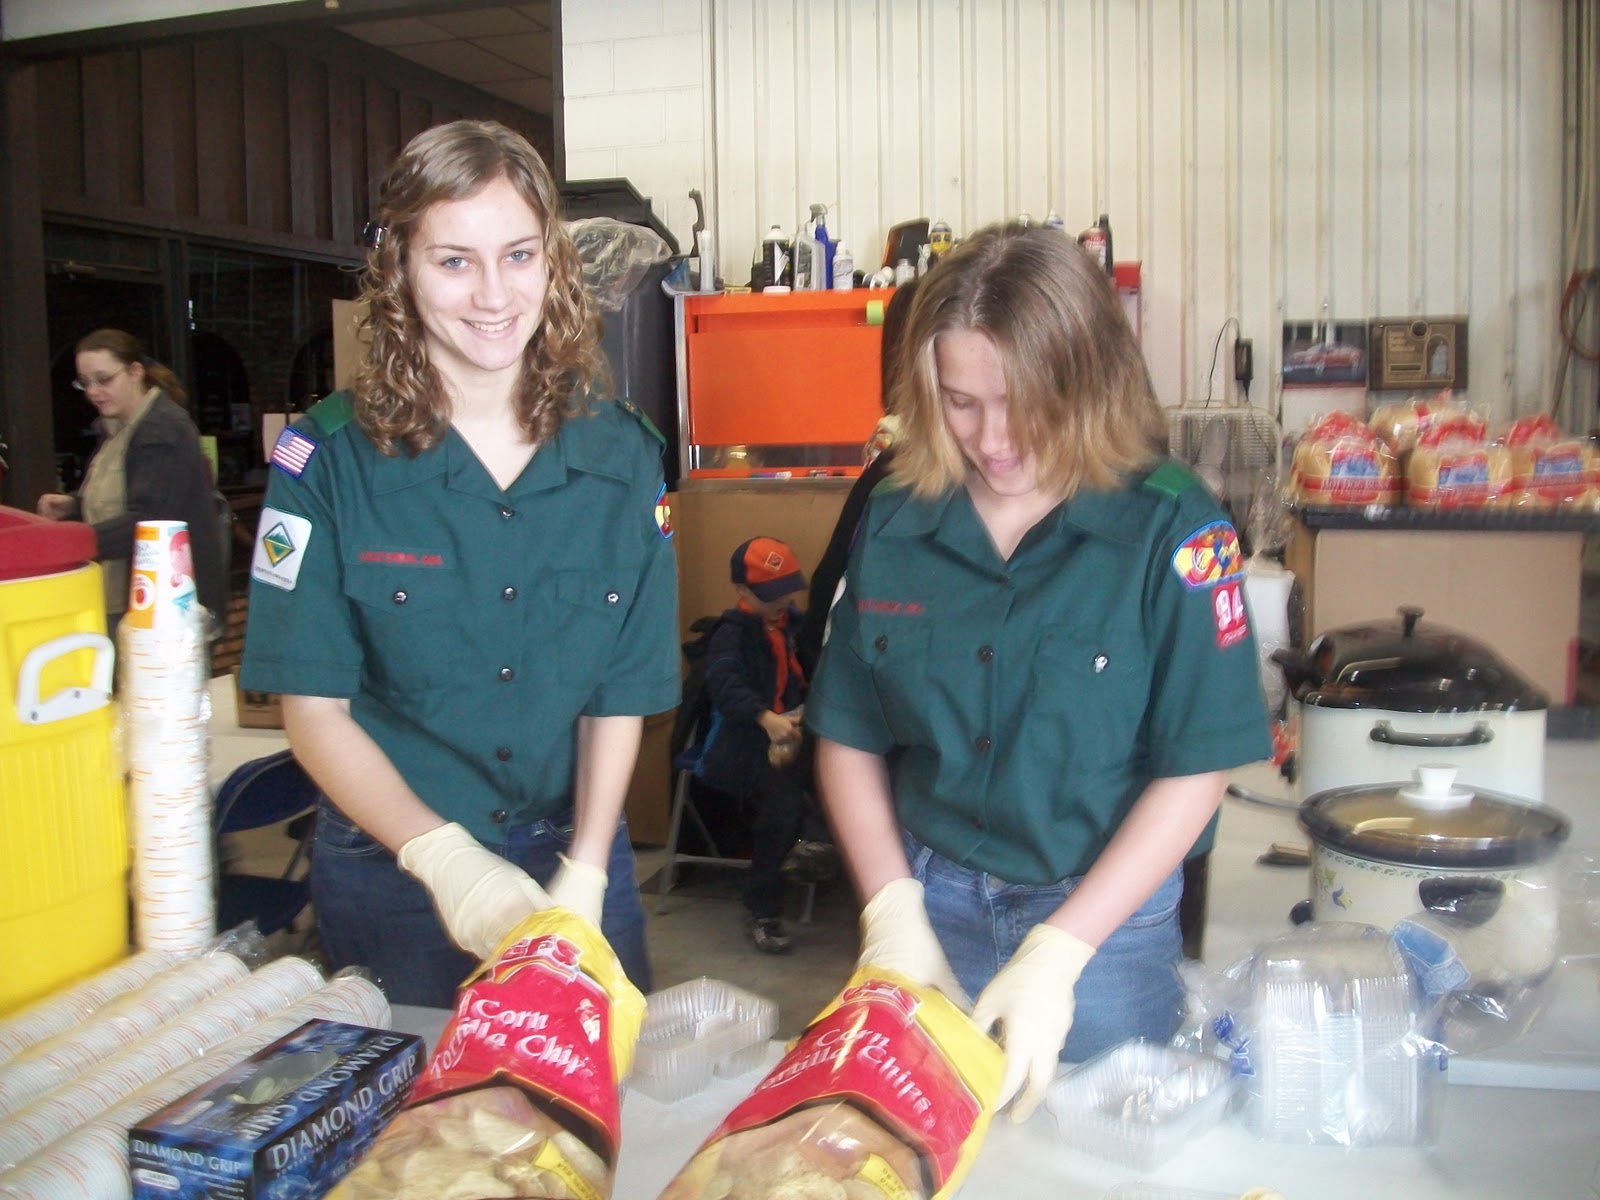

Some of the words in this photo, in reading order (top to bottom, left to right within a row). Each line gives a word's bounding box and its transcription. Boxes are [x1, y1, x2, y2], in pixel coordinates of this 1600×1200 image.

[471, 999, 549, 1030] Corn
[814, 1028, 891, 1048] Corn
[298, 1035, 404, 1102] DIAMOND
[761, 1046, 847, 1090] ortilla
[858, 1045, 932, 1112] Chips
[239, 1104, 298, 1140] GRIP
[272, 1086, 374, 1170] DIAMOND
[378, 1054, 417, 1096] GRIP
[133, 1140, 205, 1166] DIAMOND
[208, 1157, 242, 1174] GRIP
